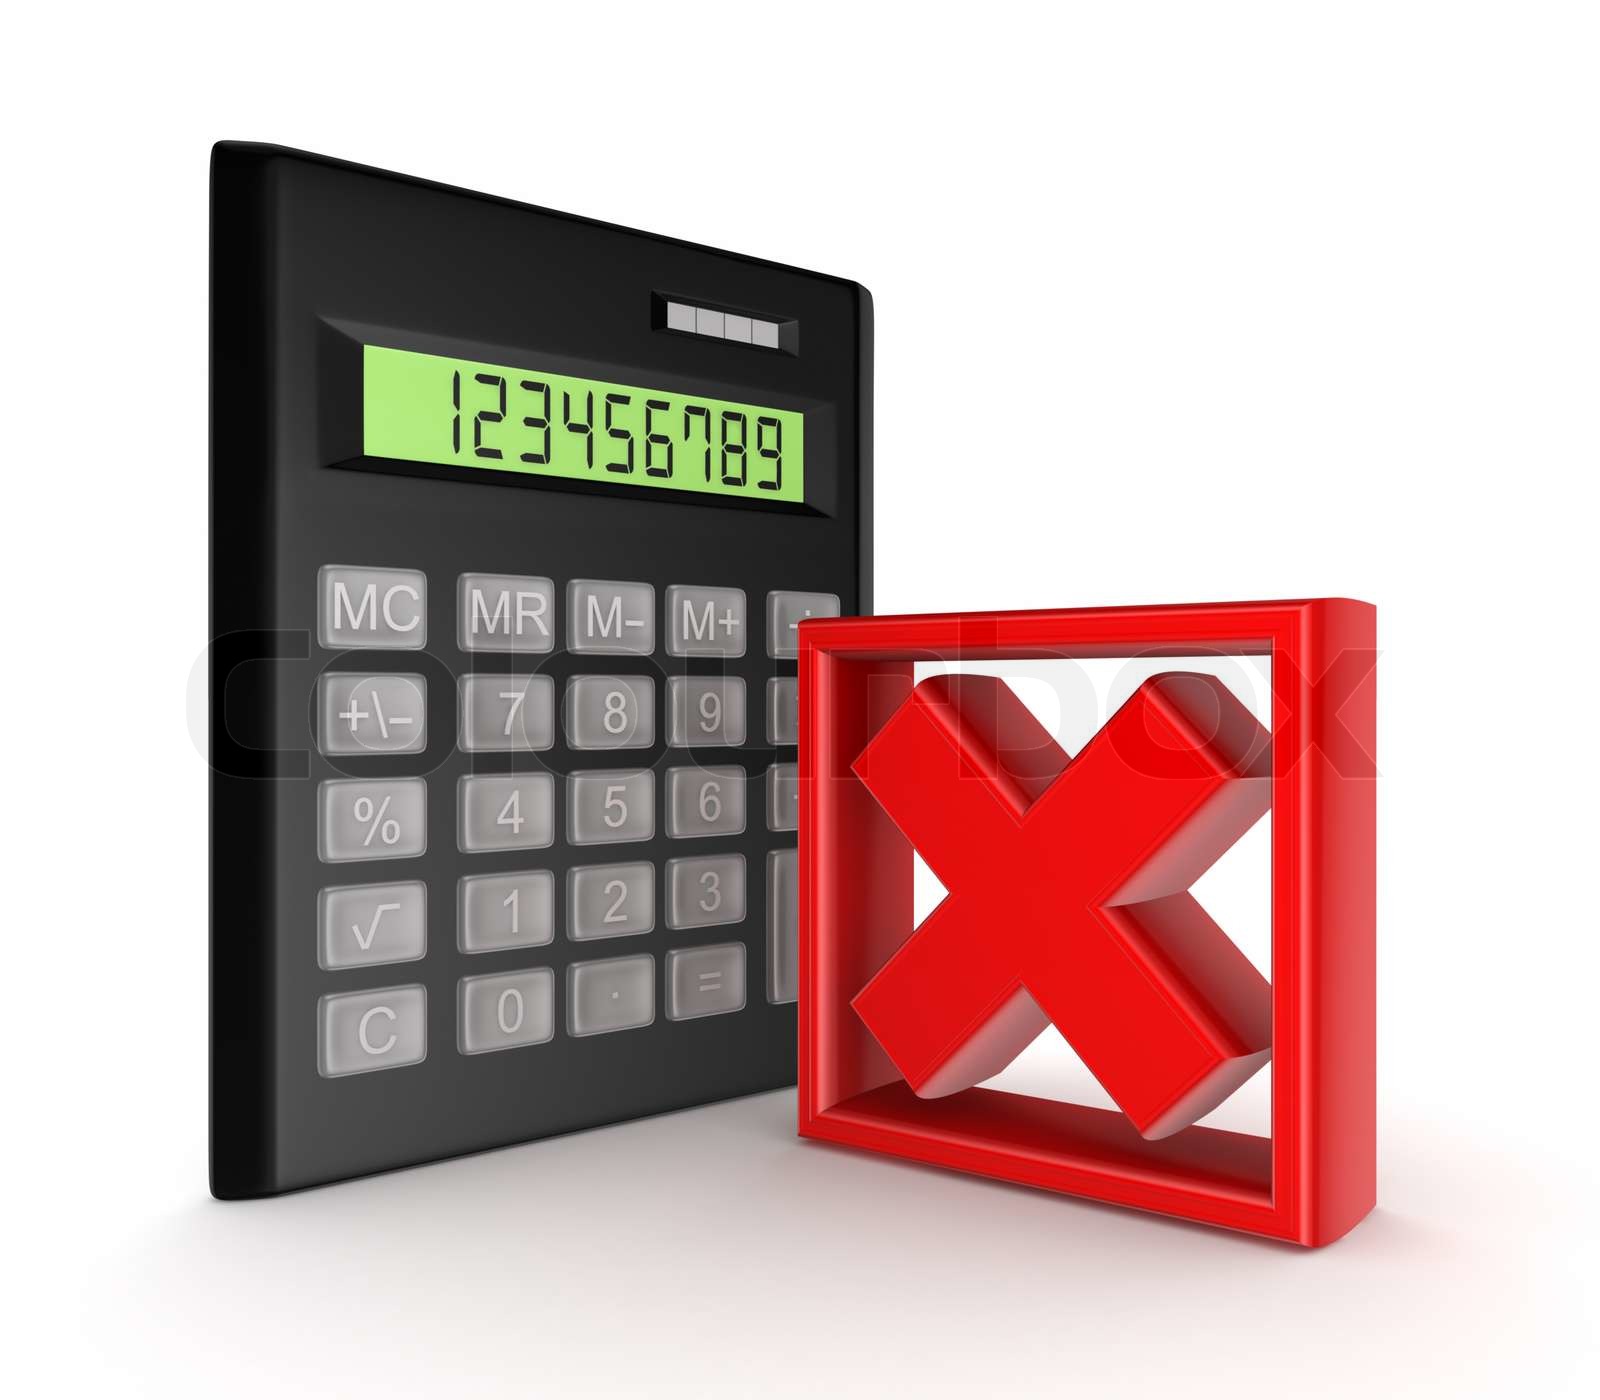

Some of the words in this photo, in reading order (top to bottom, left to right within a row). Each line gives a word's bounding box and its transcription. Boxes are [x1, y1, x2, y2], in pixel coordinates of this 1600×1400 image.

[451, 369, 783, 492] 123456789
[333, 582, 421, 632] MC
[471, 589, 550, 636] MR
[682, 600, 740, 641] M+
[499, 691, 526, 736] 7
[603, 691, 628, 734] 8
[699, 692, 722, 732] 9
[353, 796, 401, 847] %
[496, 789, 525, 834] 4
[603, 786, 628, 828] 5
[699, 781, 722, 822] 6
[503, 888, 519, 933] 1
[603, 880, 628, 923] 2
[699, 871, 722, 912] 3
[358, 1006, 398, 1055] C
